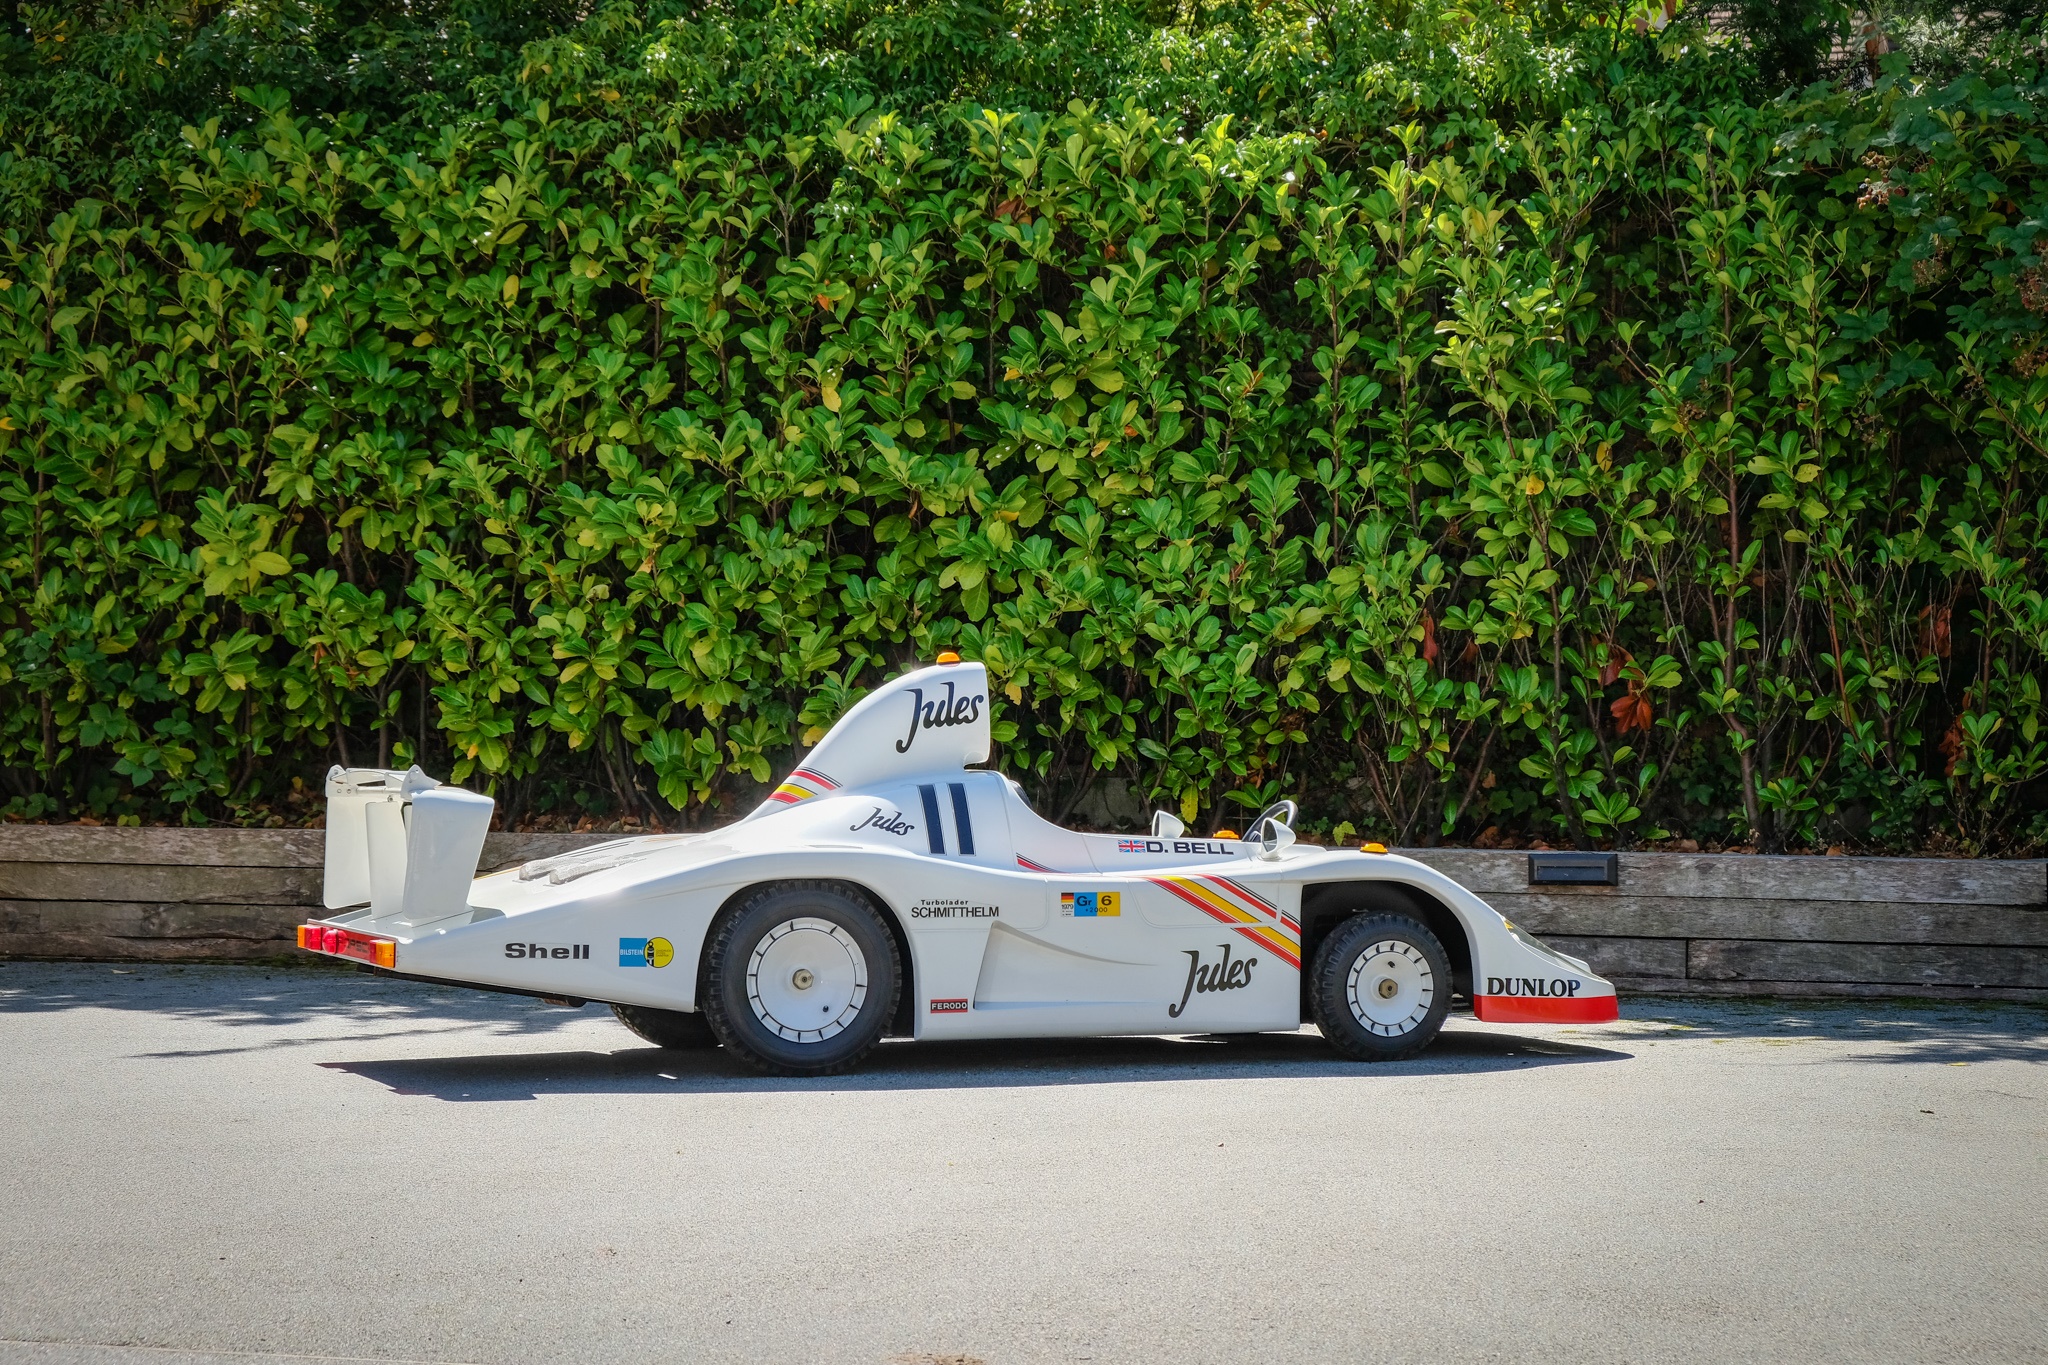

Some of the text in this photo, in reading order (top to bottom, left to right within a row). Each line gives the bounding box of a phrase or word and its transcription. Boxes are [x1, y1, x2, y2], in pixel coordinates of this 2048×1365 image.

[896, 682, 984, 753] Jules
[850, 806, 915, 835] Jules
[1146, 841, 1234, 855] D. BELL
[1077, 895, 1112, 906] Gr 6
[911, 907, 999, 918] SCHMITTHELM
[505, 943, 589, 959] Shell
[1169, 944, 1258, 1018] Jules
[1487, 978, 1581, 997] DUNLOP
